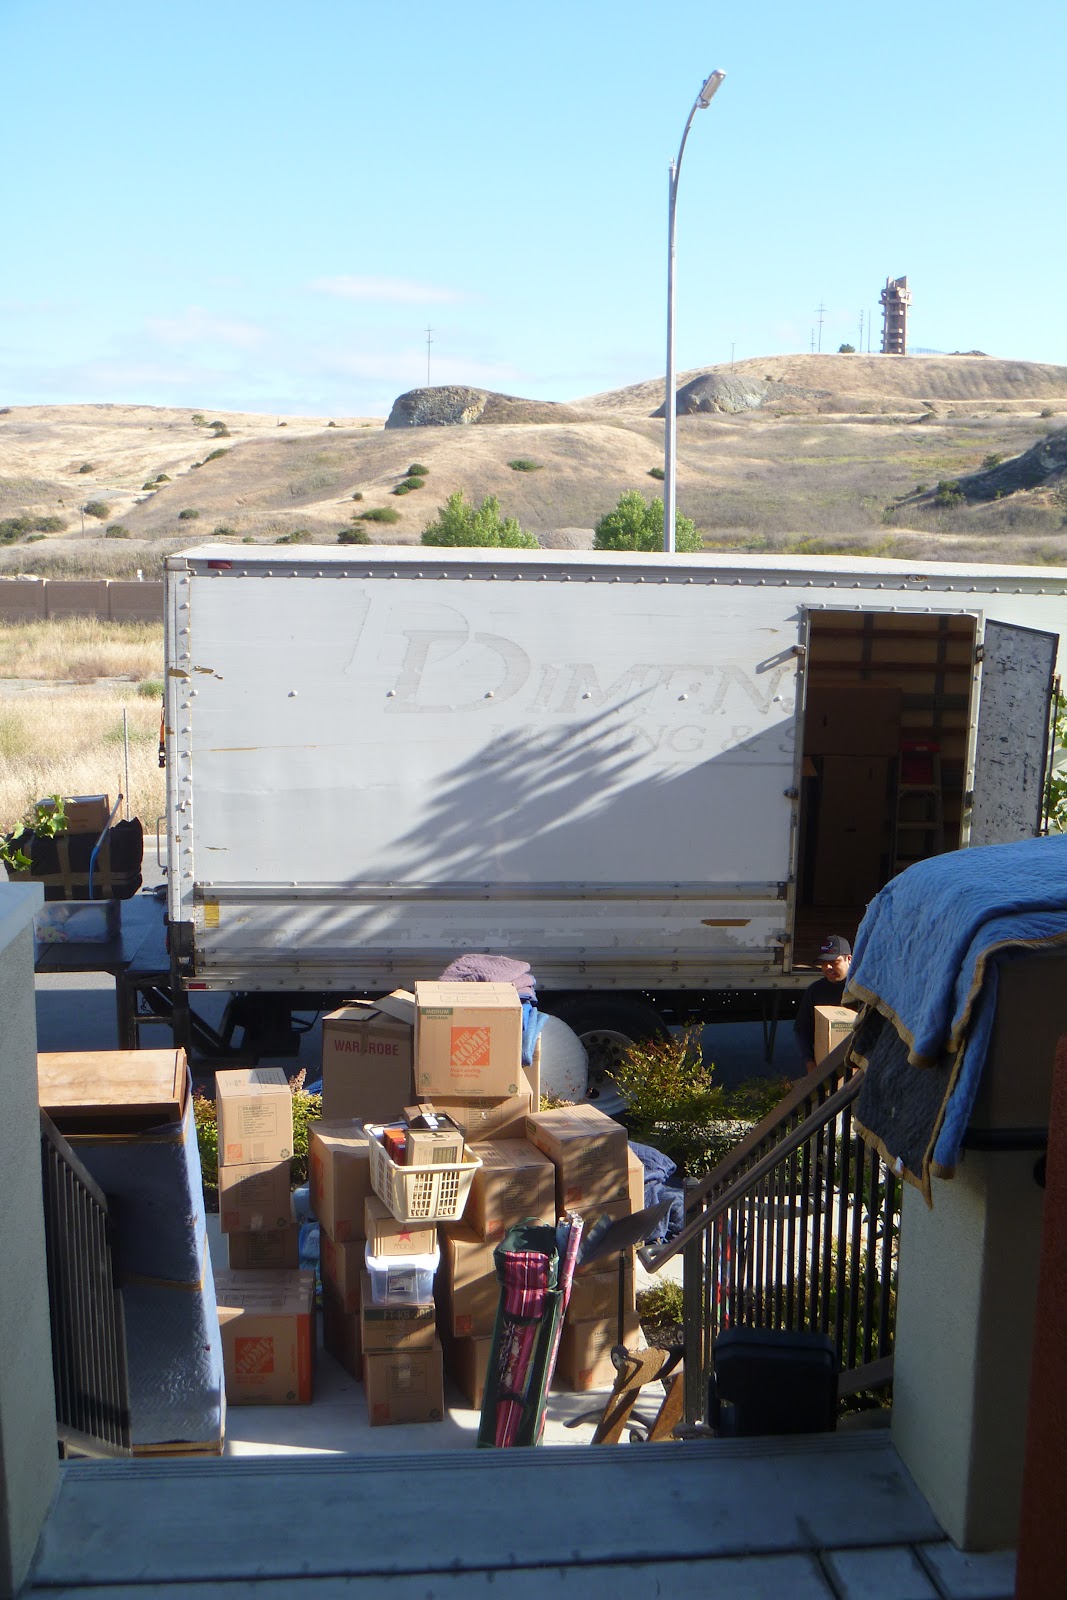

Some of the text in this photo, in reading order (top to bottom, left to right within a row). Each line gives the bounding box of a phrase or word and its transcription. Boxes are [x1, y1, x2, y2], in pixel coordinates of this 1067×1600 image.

[334, 1039, 399, 1056] WARROBE
[450, 1026, 491, 1066] HOME
[455, 1031, 472, 1047] THE
[465, 1041, 490, 1066] DEPOT
